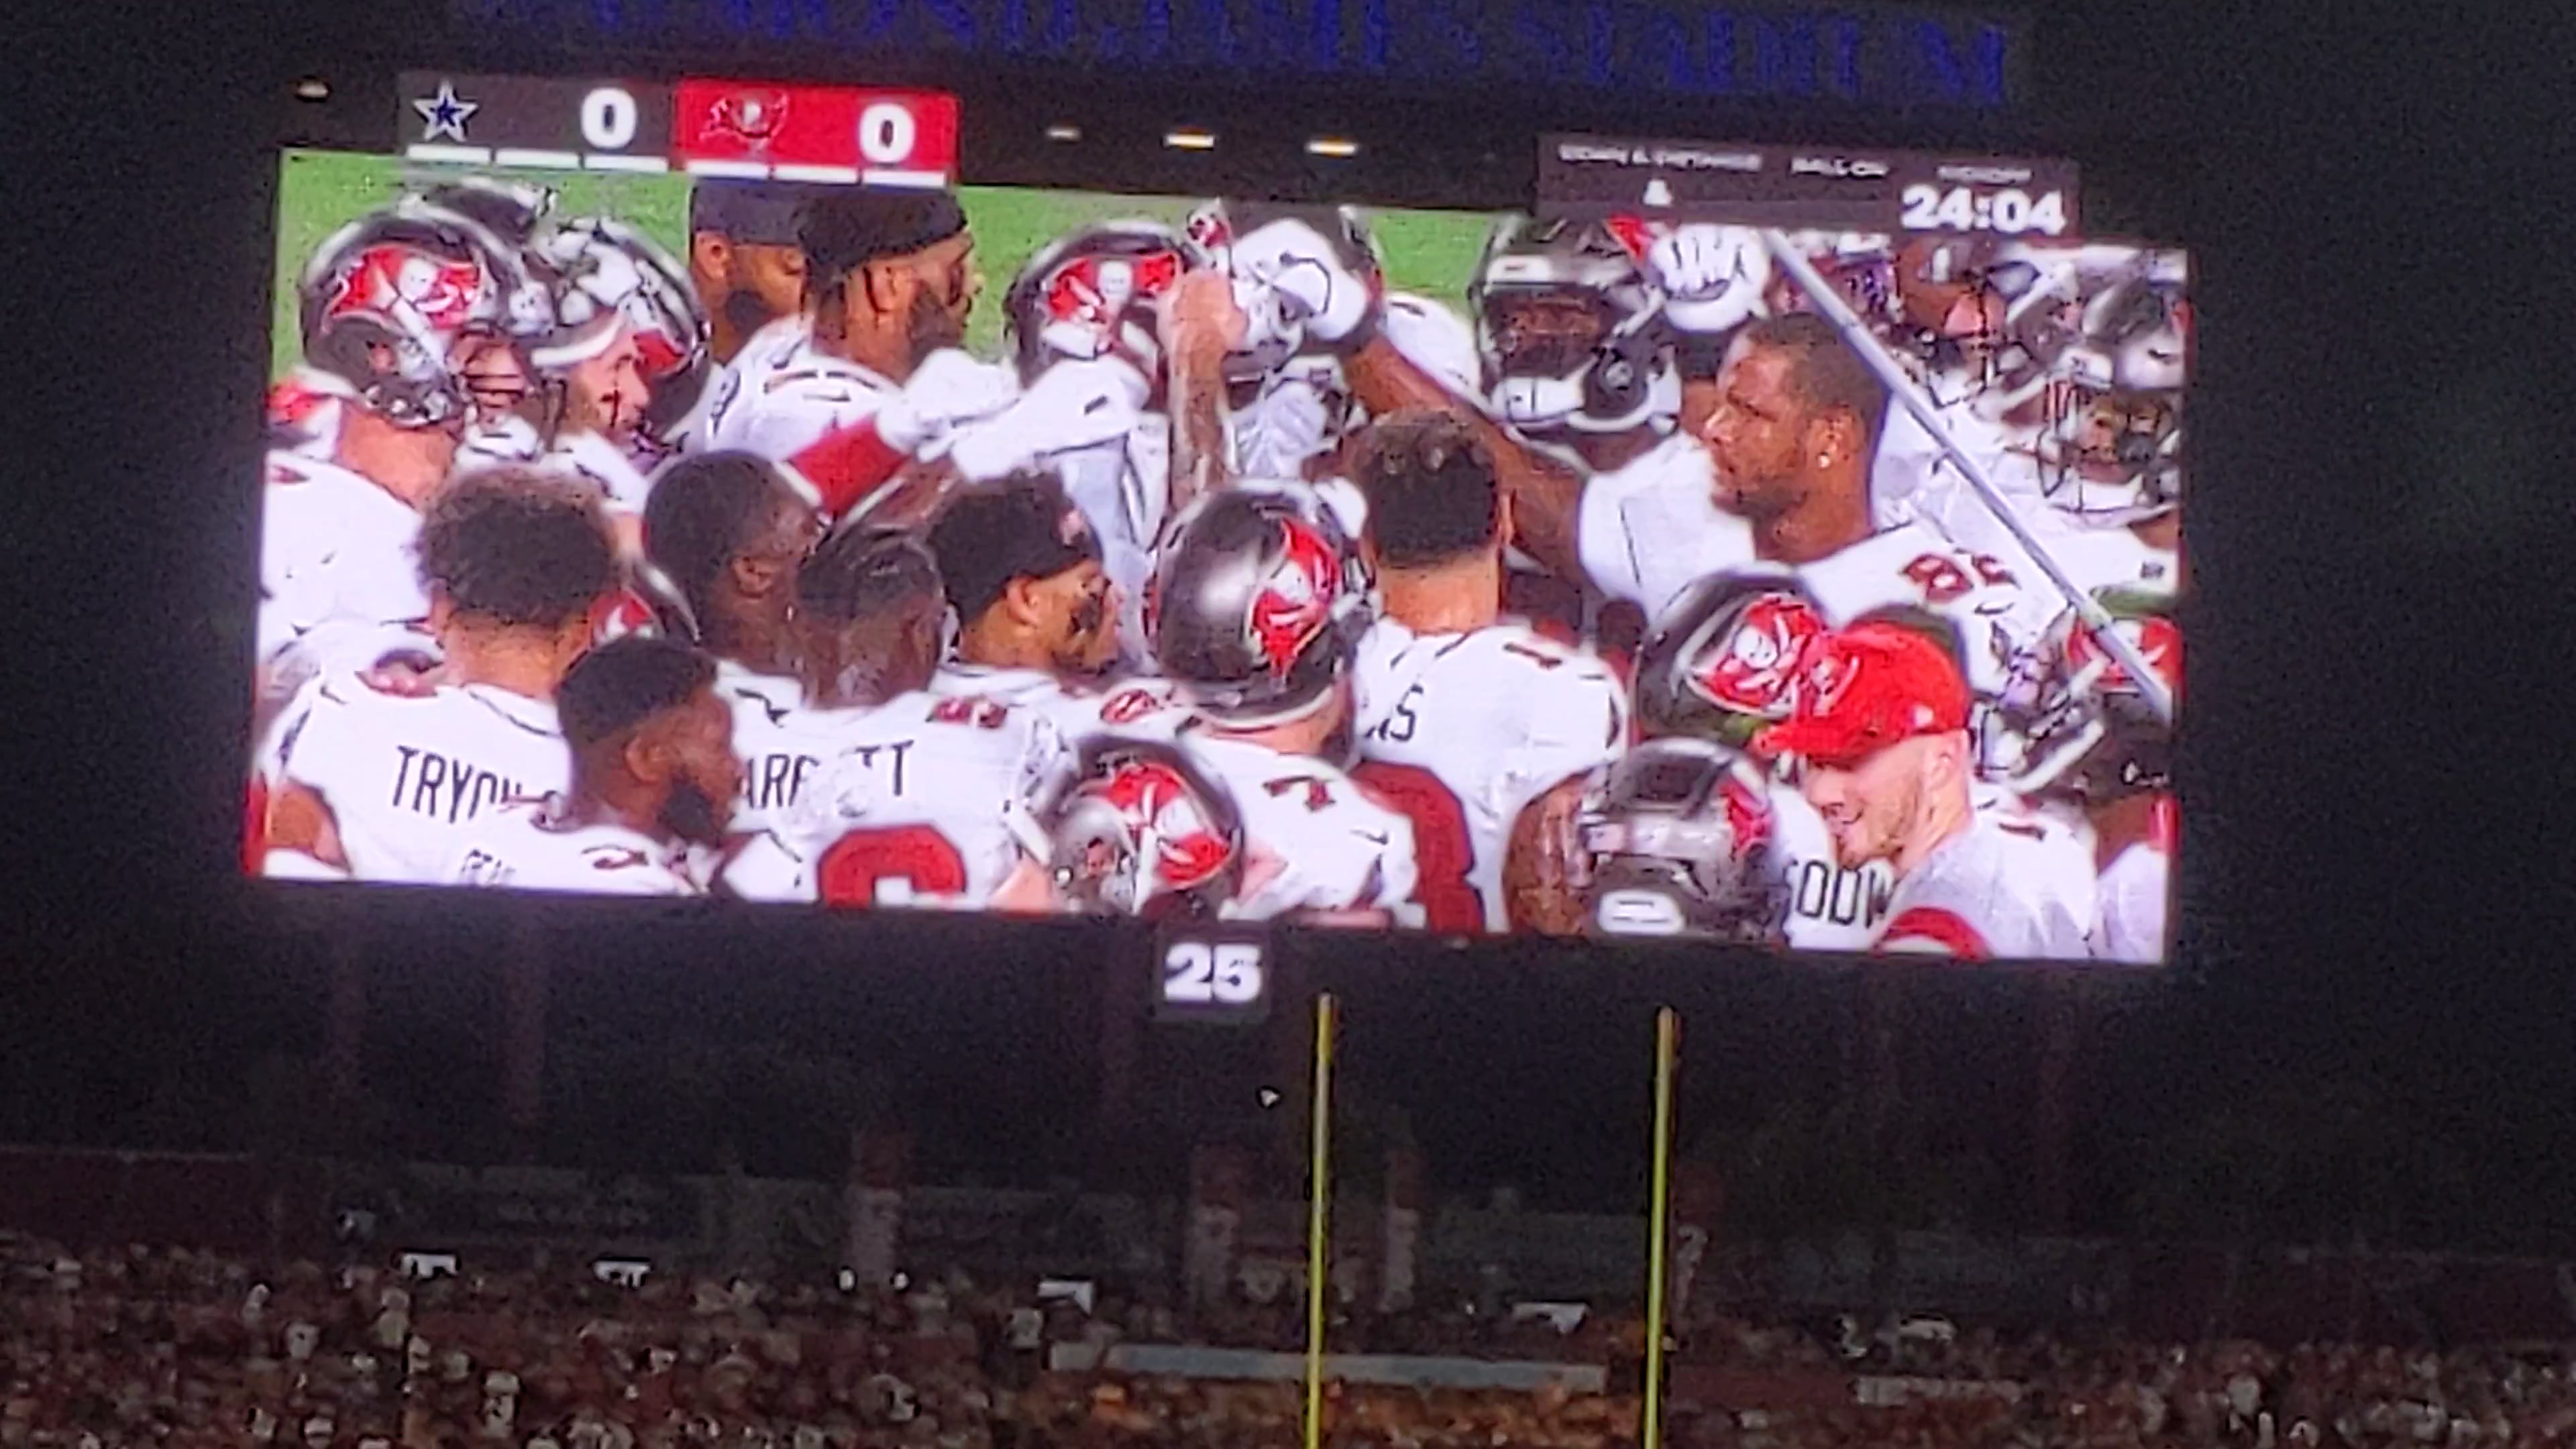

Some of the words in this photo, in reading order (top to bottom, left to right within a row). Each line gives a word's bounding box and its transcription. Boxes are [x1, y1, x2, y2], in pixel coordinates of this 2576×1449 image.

[581, 87, 637, 148] 0
[859, 103, 914, 163] 0
[1901, 183, 2068, 235] 24:04
[1164, 941, 1263, 1004] 25
